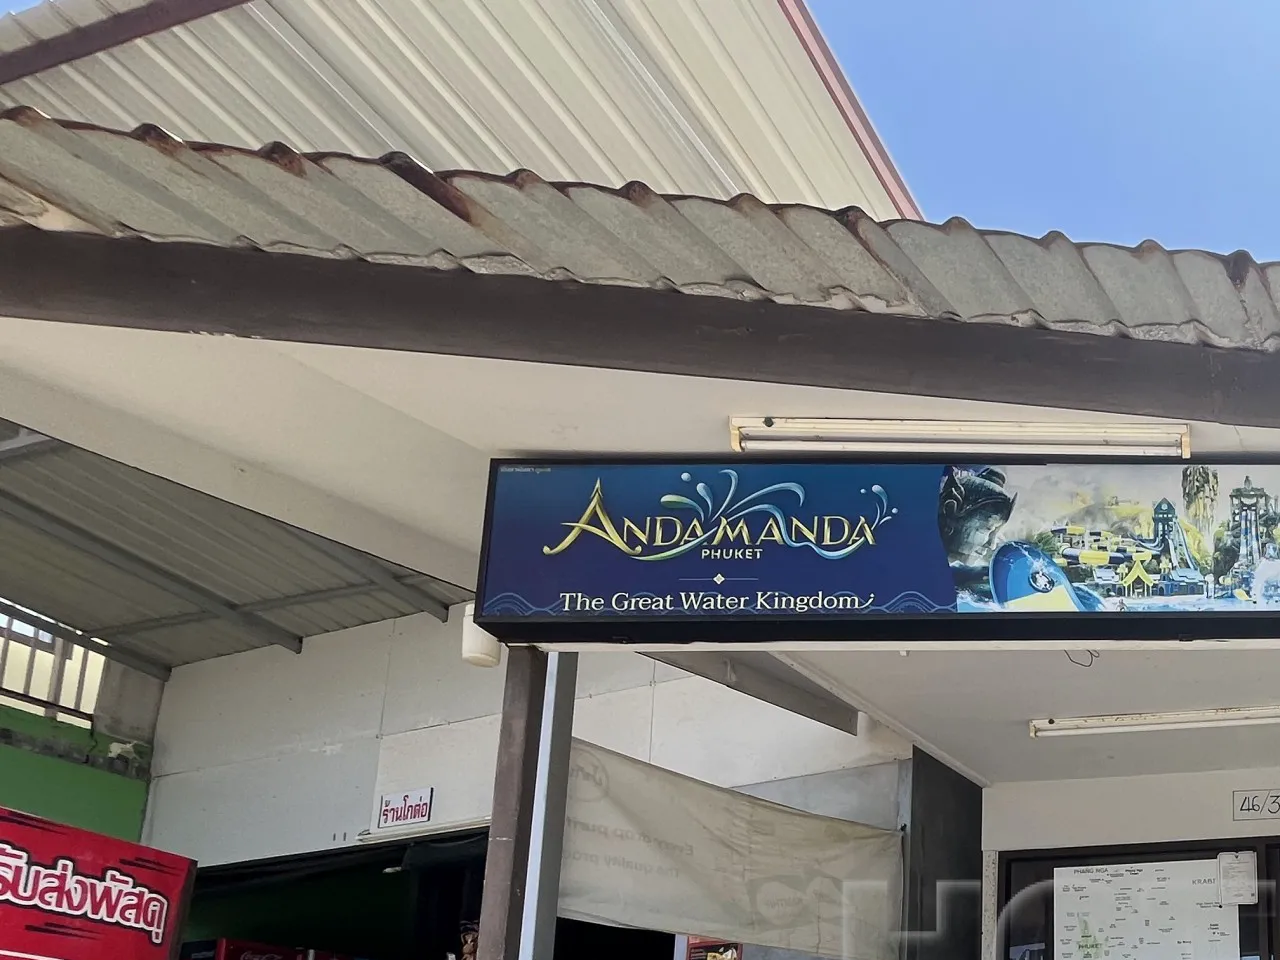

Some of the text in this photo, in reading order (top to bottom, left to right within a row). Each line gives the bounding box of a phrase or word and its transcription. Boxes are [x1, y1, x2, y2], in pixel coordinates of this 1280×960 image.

[543, 477, 878, 556] ANDAMANDA
[701, 548, 764, 560] PHUKET
[560, 591, 874, 613] The Great Water Kingdom
[1240, 790, 1280, 814] 46/3
